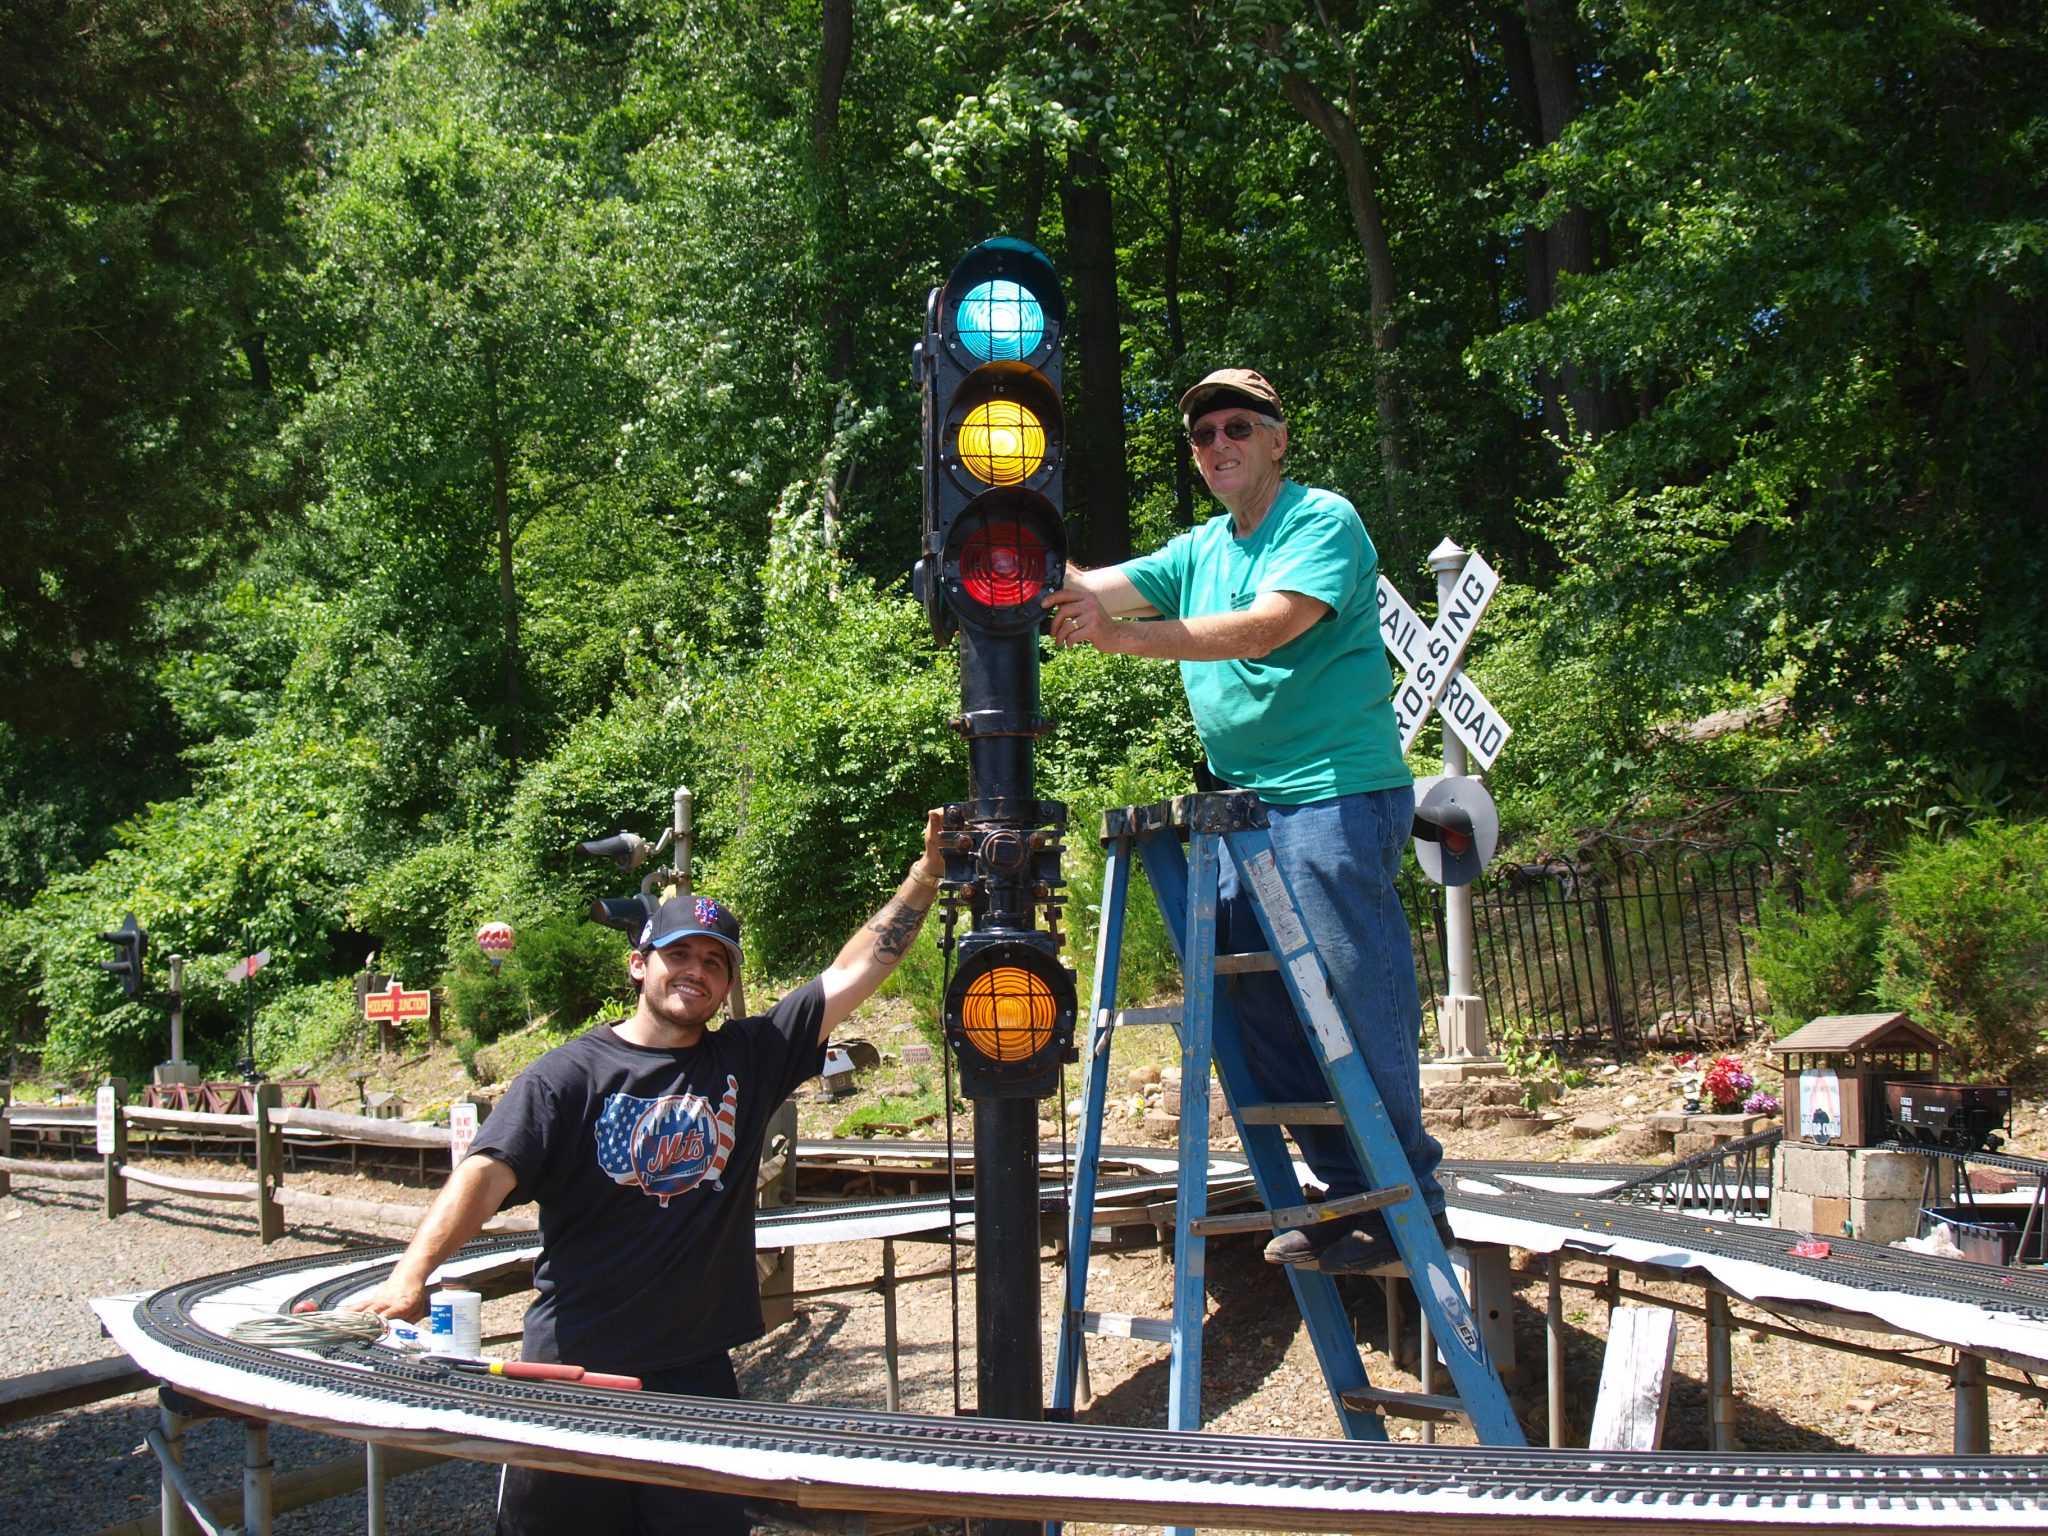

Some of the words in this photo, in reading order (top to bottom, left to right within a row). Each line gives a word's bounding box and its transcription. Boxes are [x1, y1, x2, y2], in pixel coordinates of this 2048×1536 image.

[1396, 574, 1485, 741] ROSSING
[1441, 677, 1502, 757] ROAD
[398, 997, 427, 1012] JUNCTION
[647, 1129, 704, 1172] Mets
